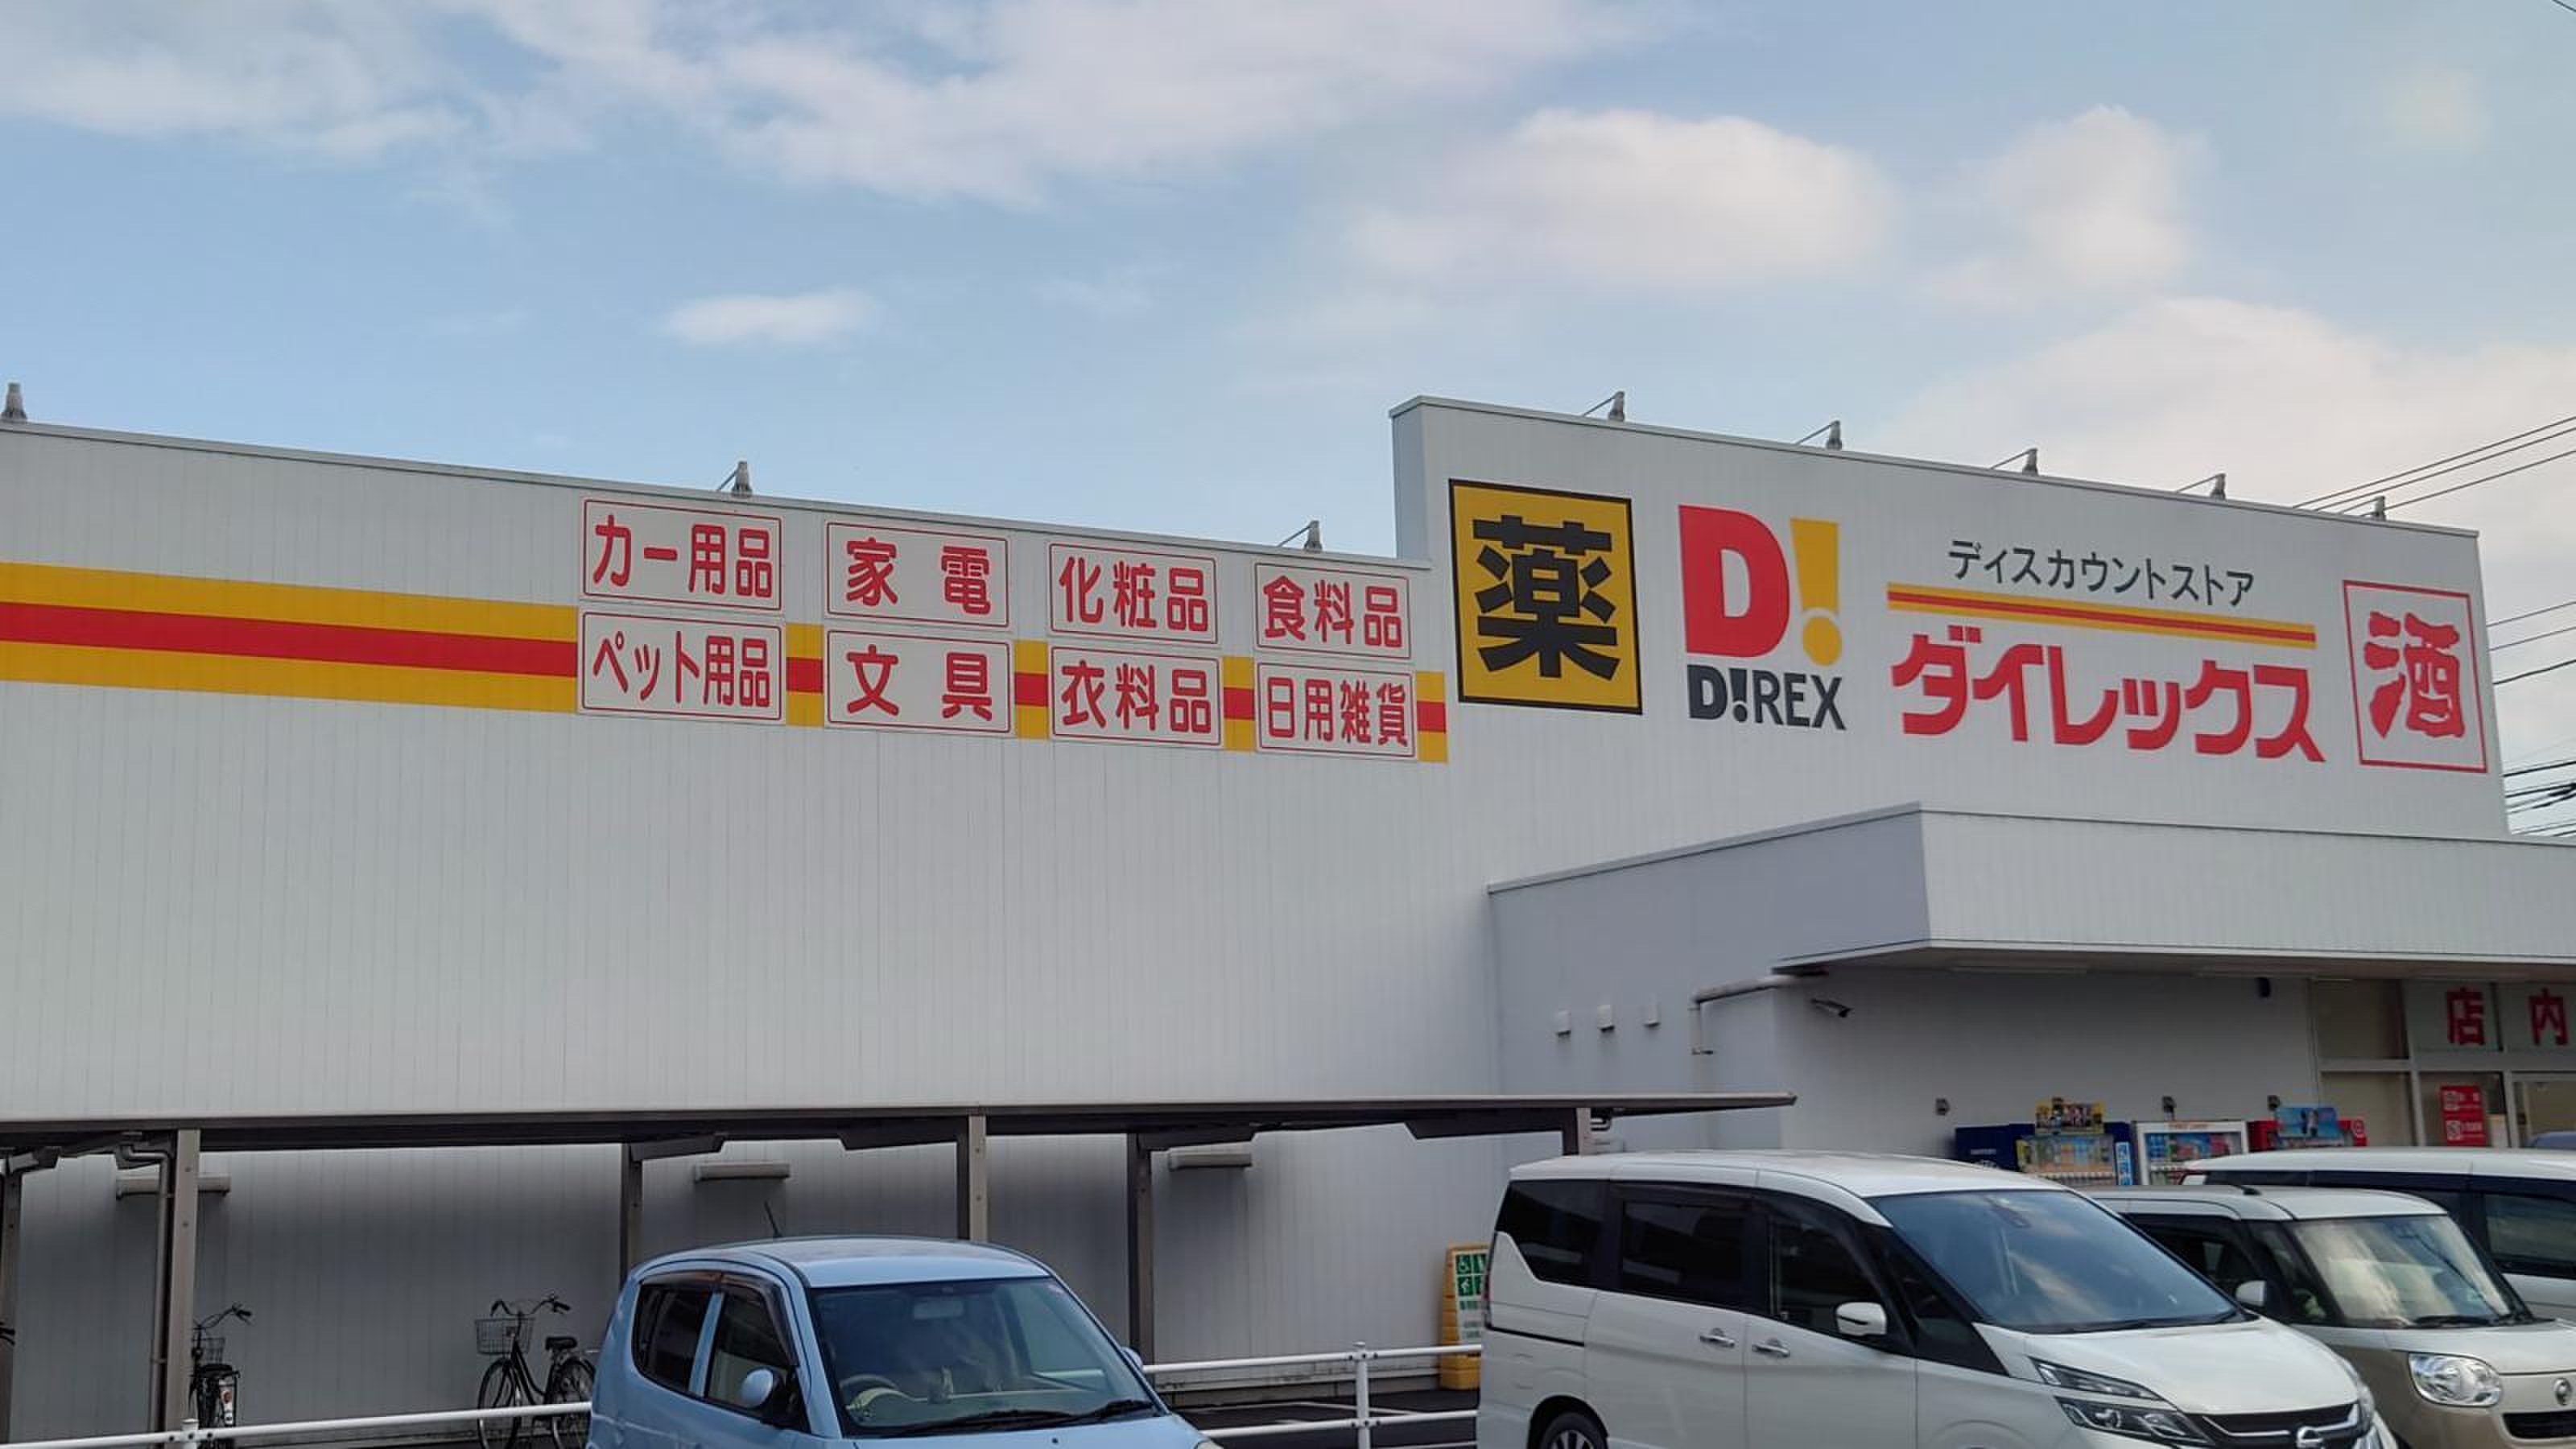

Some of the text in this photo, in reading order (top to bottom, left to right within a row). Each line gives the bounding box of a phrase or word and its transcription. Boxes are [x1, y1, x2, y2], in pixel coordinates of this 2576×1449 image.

[593, 514, 773, 597] カー用品
[846, 537, 992, 615] 家電
[1948, 540, 2254, 606] ディスカウントストア
[1059, 557, 1209, 632] 化粧品
[1262, 576, 1403, 647] 食料品
[1472, 515, 1620, 681] 薬
[592, 631, 770, 708] ペット用品
[847, 645, 993, 722] 文具
[1061, 660, 1212, 733] 衣料品
[1891, 625, 2326, 762] ダイレックス
[2363, 611, 2465, 737] 酒
[1266, 677, 1408, 747] 日用雑貨
